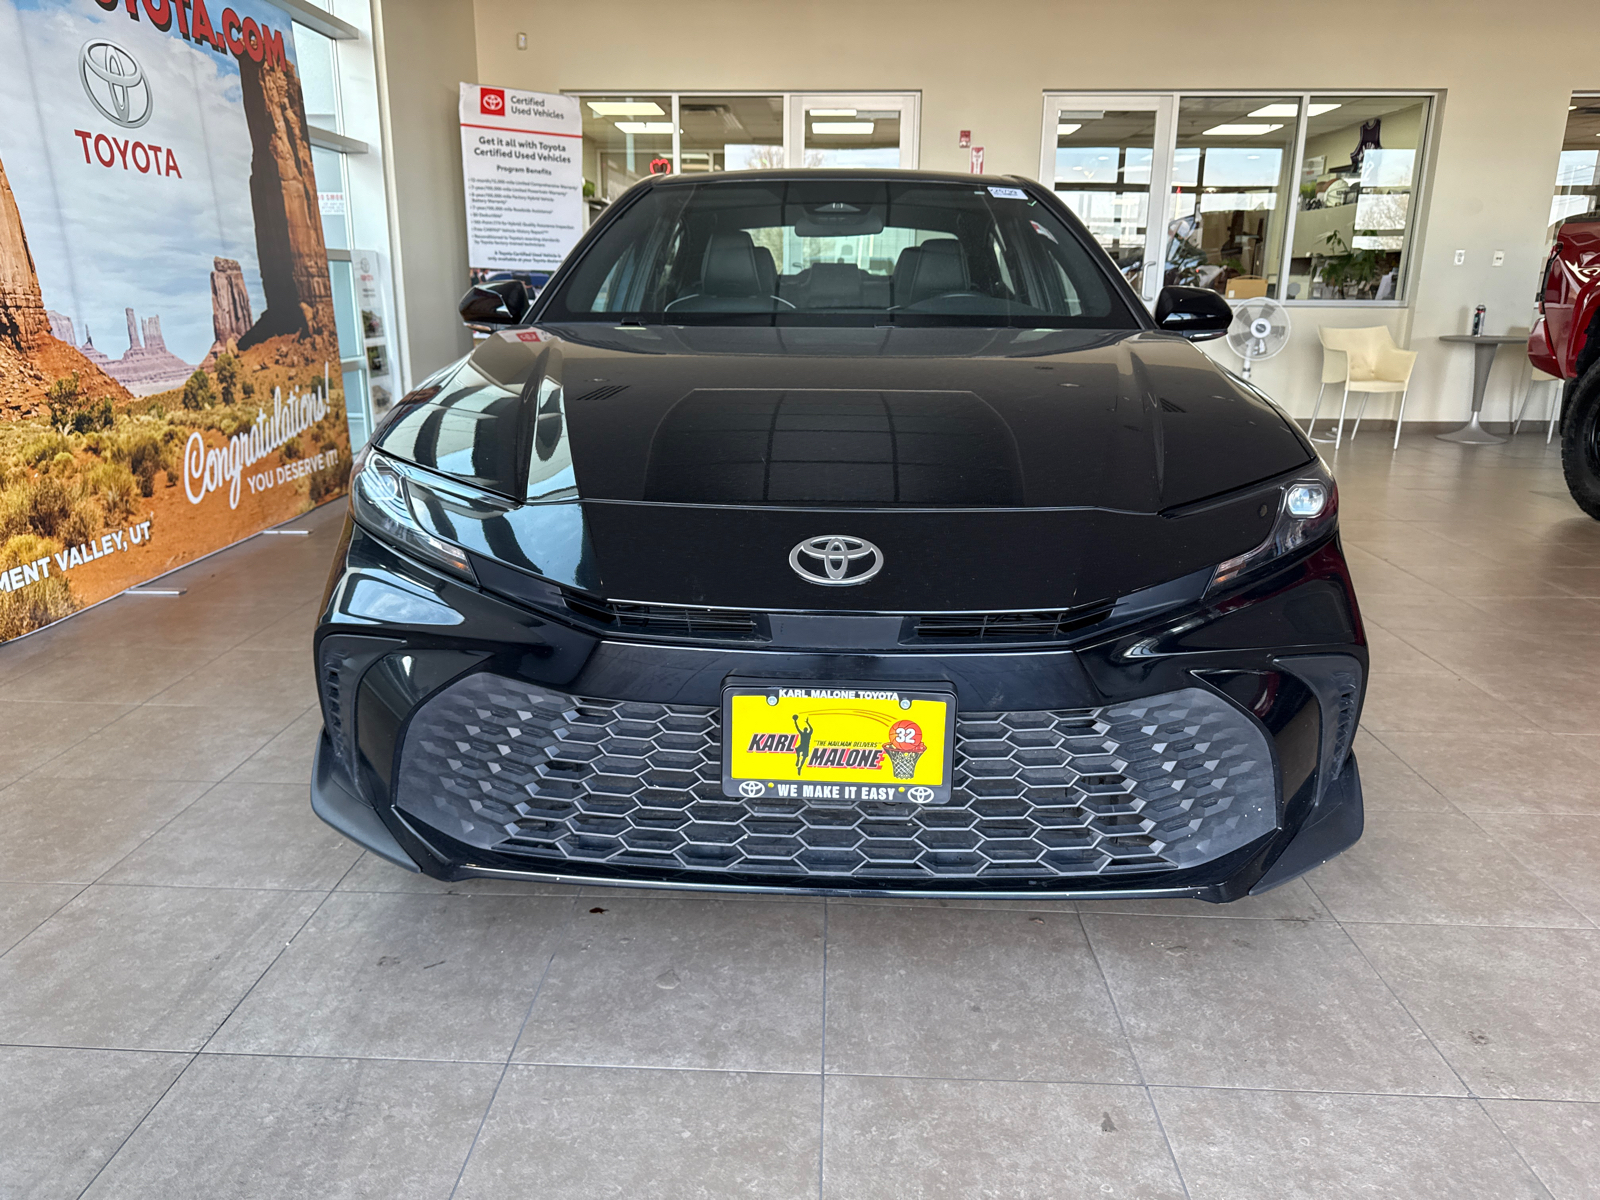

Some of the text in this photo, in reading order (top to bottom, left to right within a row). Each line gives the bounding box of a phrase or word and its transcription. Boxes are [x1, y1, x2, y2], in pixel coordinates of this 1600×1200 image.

[511, 96, 545, 107] Certified
[511, 106, 564, 119] Used Vehicles
[479, 136, 566, 152] Get it all with Toyota
[74, 129, 182, 179] TOYOTA
[474, 147, 571, 163] Certified Used Vehicles
[497, 165, 552, 175] Program Benefits
[183, 361, 331, 510] Congratulations!
[246, 448, 338, 495] YOU DESERVE IT!
[54, 531, 128, 571] VALLEY,
[130, 520, 152, 544] UT
[779, 688, 900, 702] KARL MALONE TOYOTA
[747, 732, 801, 754] KARL
[827, 740, 852, 748] MAILMAN
[895, 727, 916, 744] 32
[806, 747, 886, 770] MALONE
[777, 784, 896, 801] WE MAKE IT EASY
